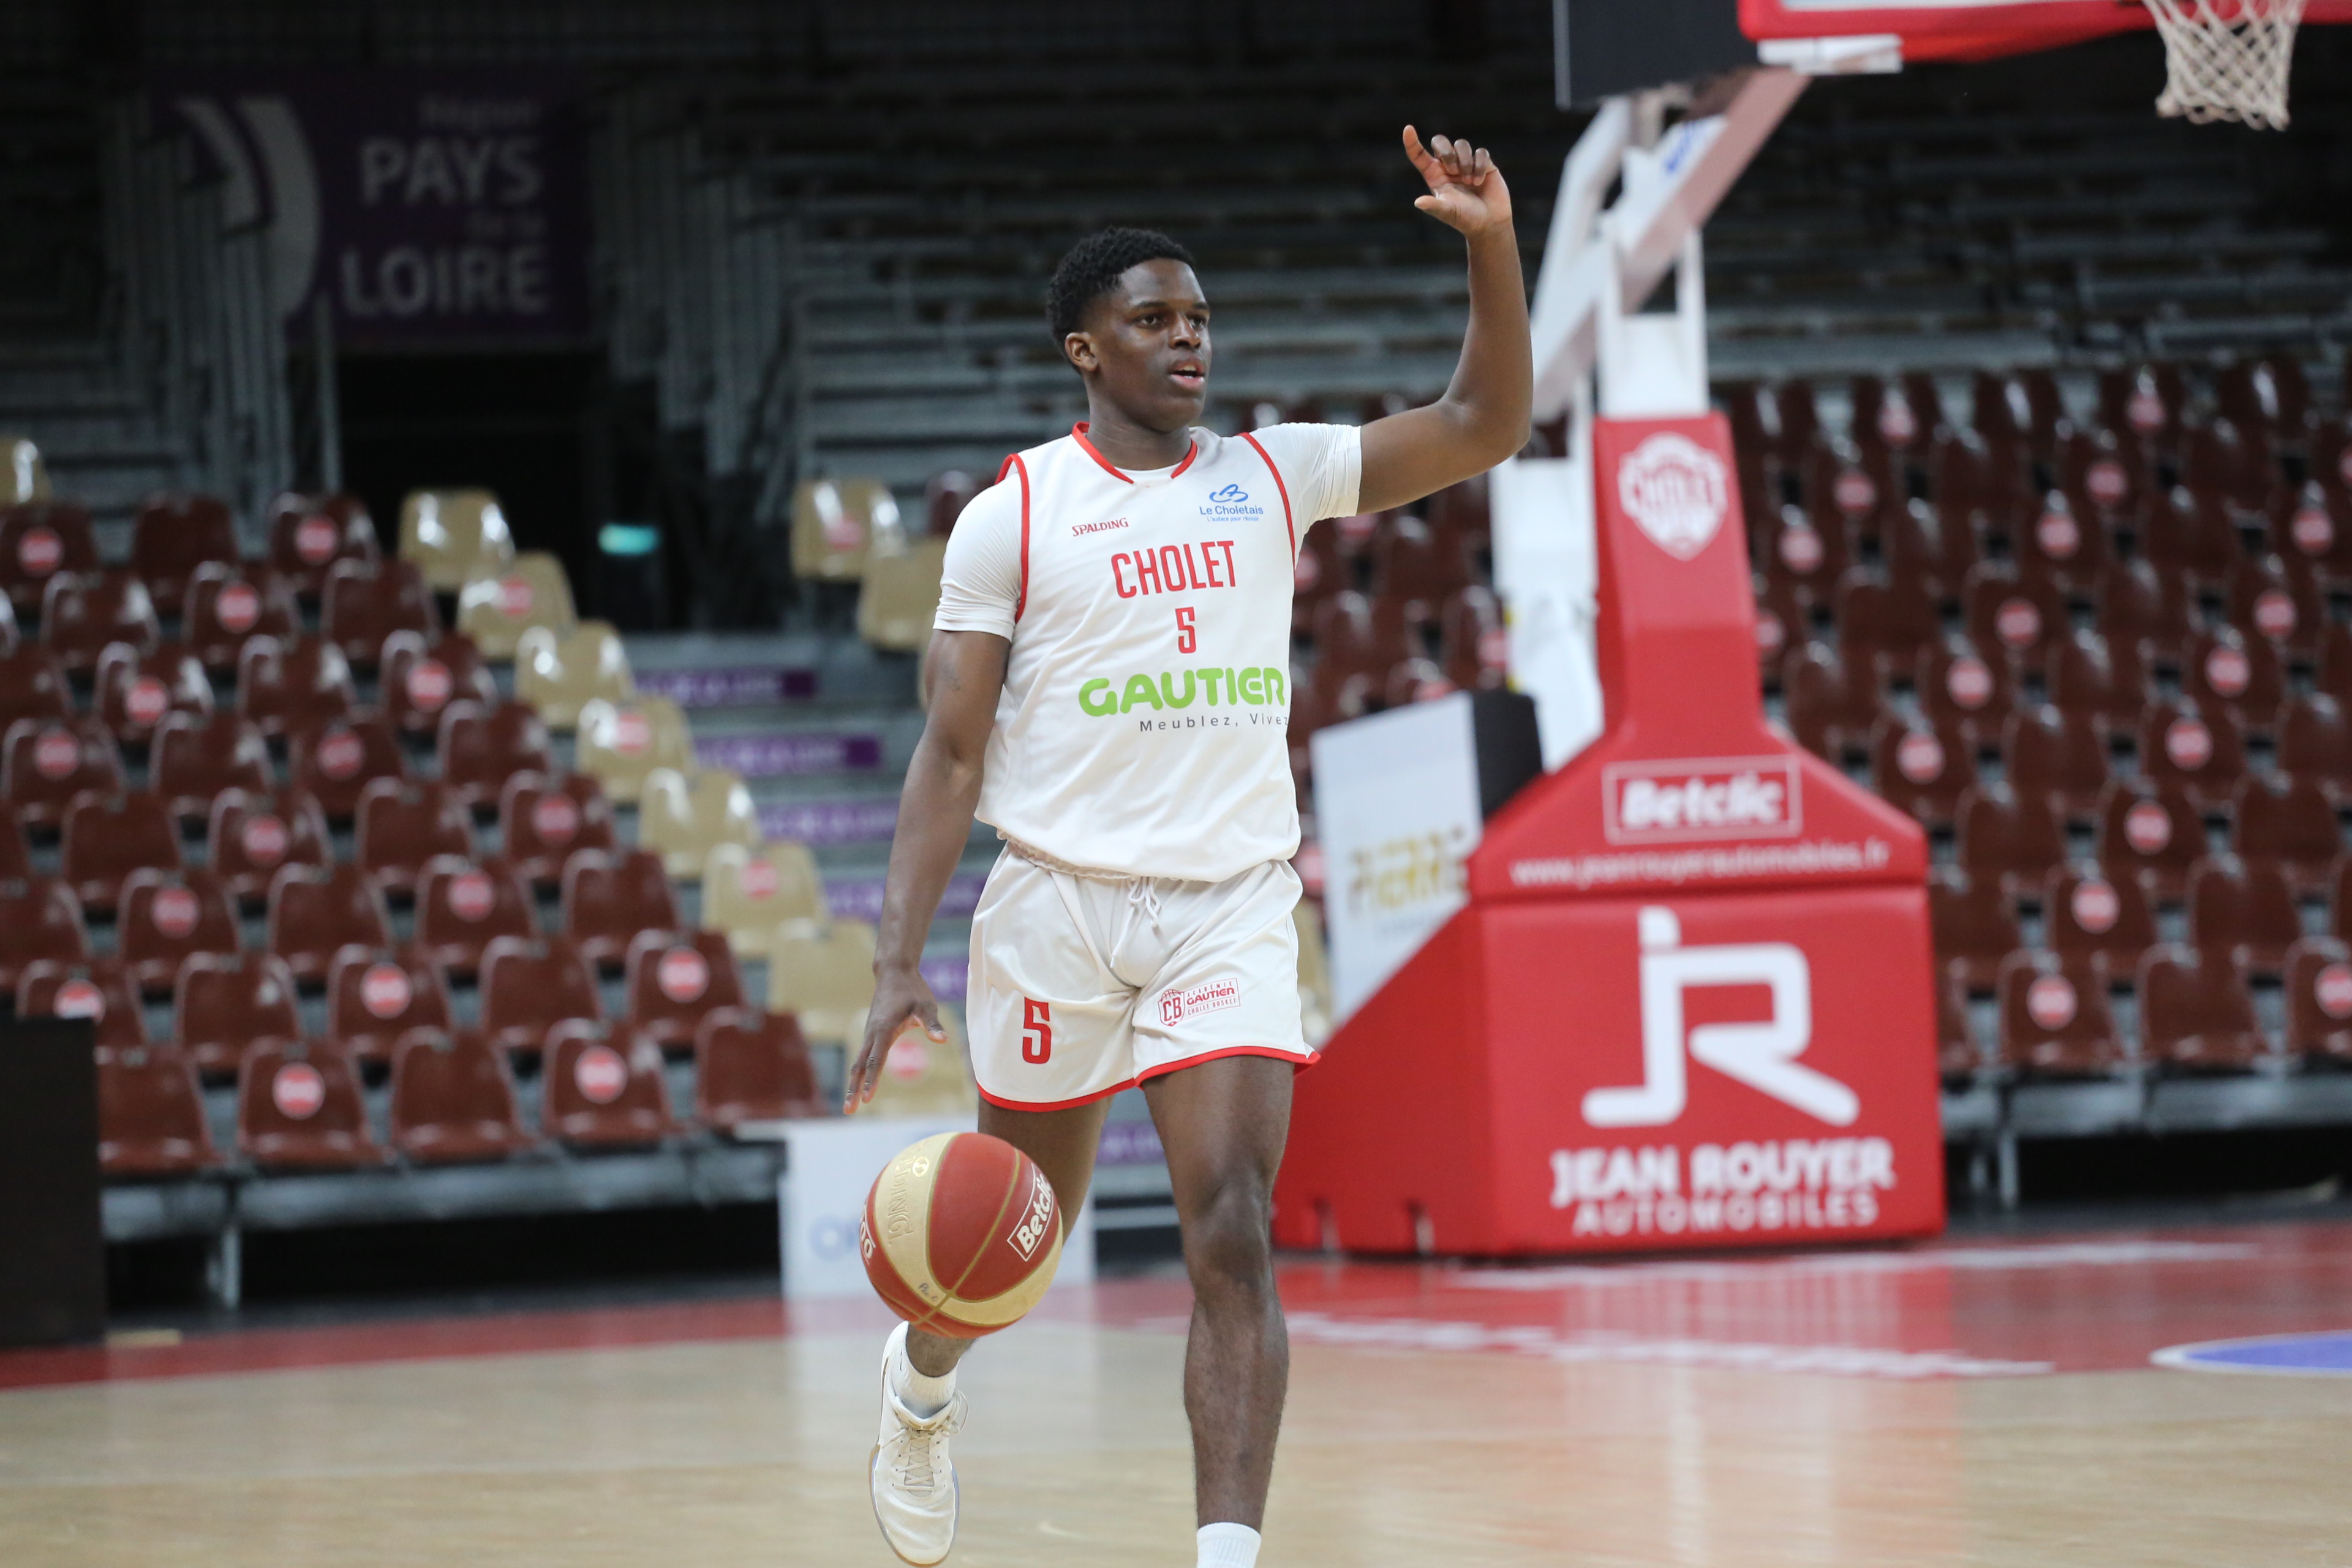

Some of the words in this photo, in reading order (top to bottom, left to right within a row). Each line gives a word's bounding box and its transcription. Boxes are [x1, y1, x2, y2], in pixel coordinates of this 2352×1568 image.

[360, 137, 544, 205] PAYS
[341, 244, 549, 316] LOIRE
[1072, 518, 1129, 537] SPALDING
[1199, 506, 1212, 514] Le
[1215, 505, 1264, 514] Choletais
[1111, 540, 1236, 598] CHOLET
[1175, 607, 1196, 654] 5
[1079, 667, 1285, 717] GAUTIER
[1140, 715, 1238, 731] Meublez,
[1621, 772, 1782, 827] Betclic
[1163, 997, 1182, 1022] CB
[1187, 987, 1235, 1005] GAUTIER
[1188, 1005, 1210, 1015] CHOLET
[1212, 998, 1237, 1008] BASKET
[1022, 997, 1052, 1064] 5
[1550, 1145, 1681, 1208] JEAN
[1690, 1136, 1896, 1193] ROUYER
[1572, 1187, 1878, 1237] AUTOMOBILES
